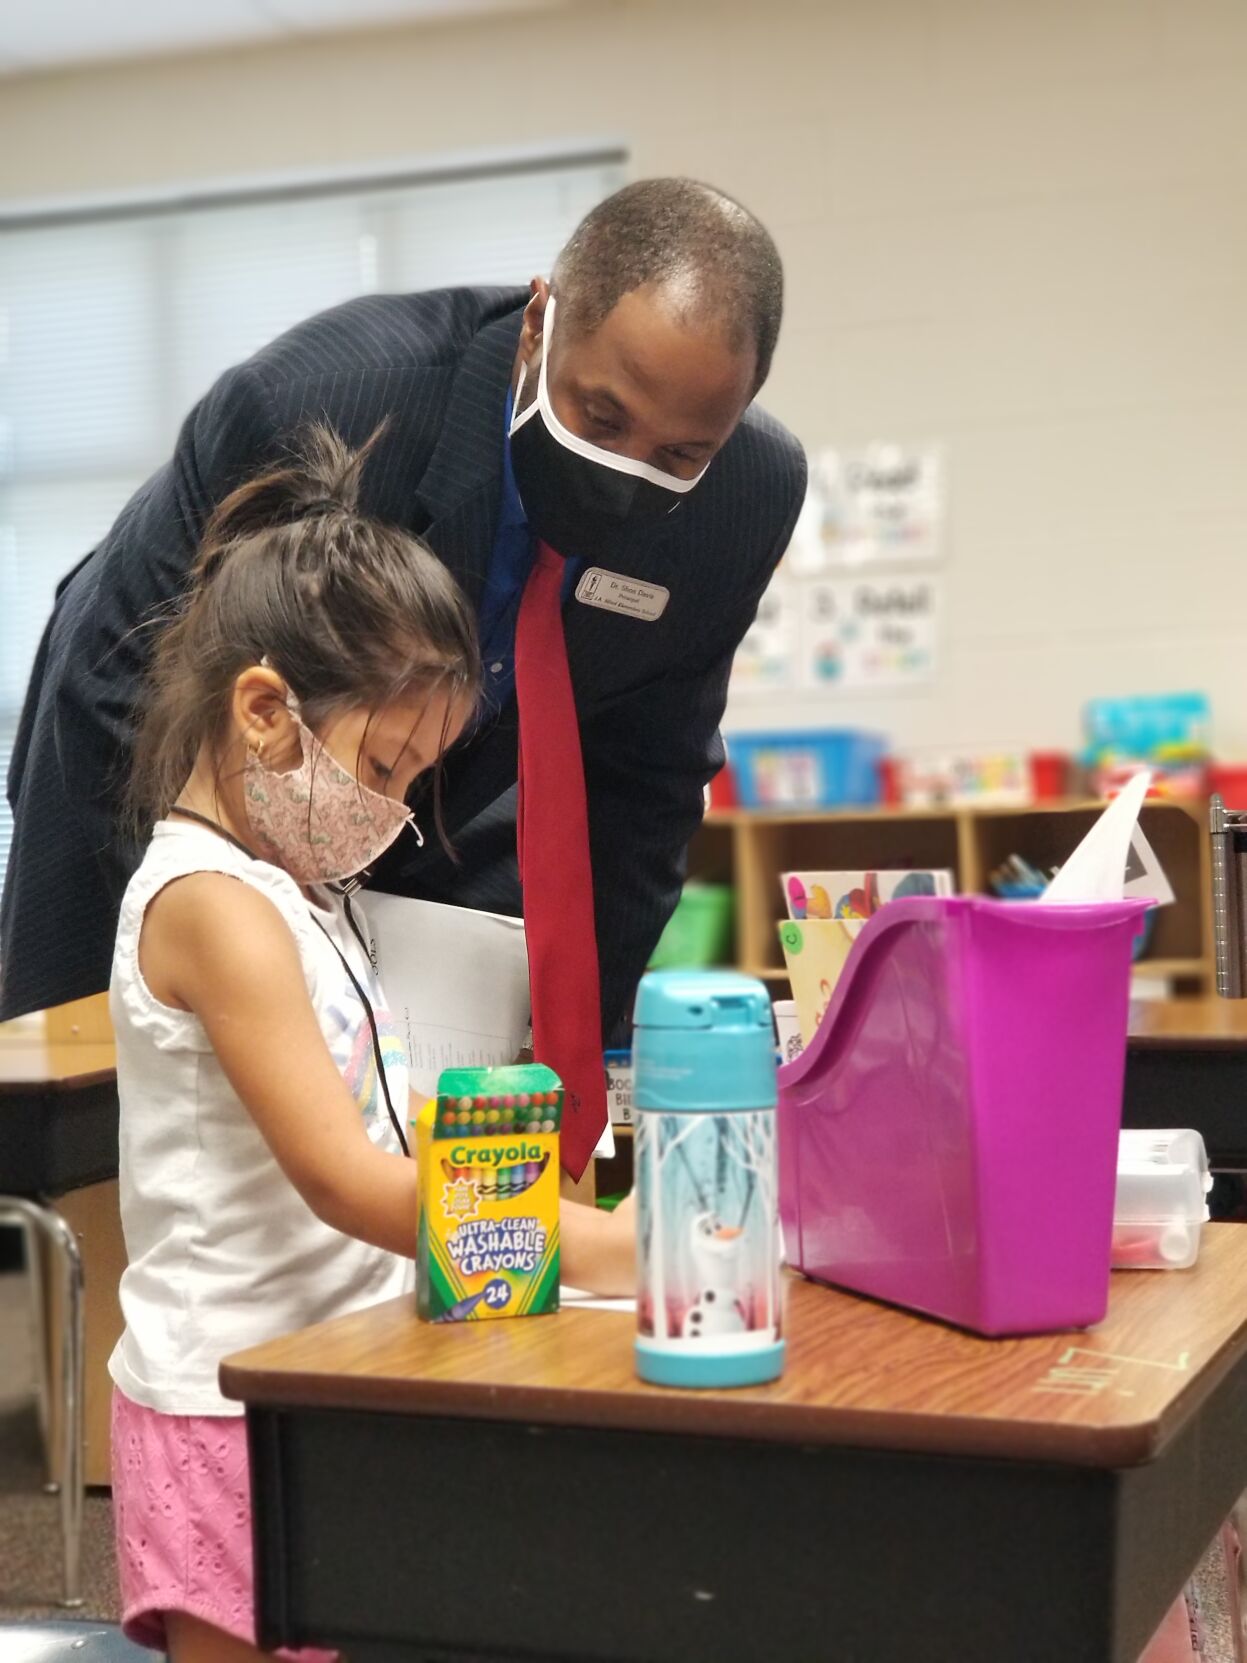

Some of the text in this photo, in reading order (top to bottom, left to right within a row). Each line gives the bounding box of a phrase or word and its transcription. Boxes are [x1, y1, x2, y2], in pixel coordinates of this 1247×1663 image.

[450, 1141, 541, 1167] Crayola
[457, 1217, 537, 1237] ULTRA-CLEAN
[447, 1230, 546, 1259] WASHABLE
[460, 1251, 535, 1276] CRAYONS
[486, 1283, 509, 1304] 24
